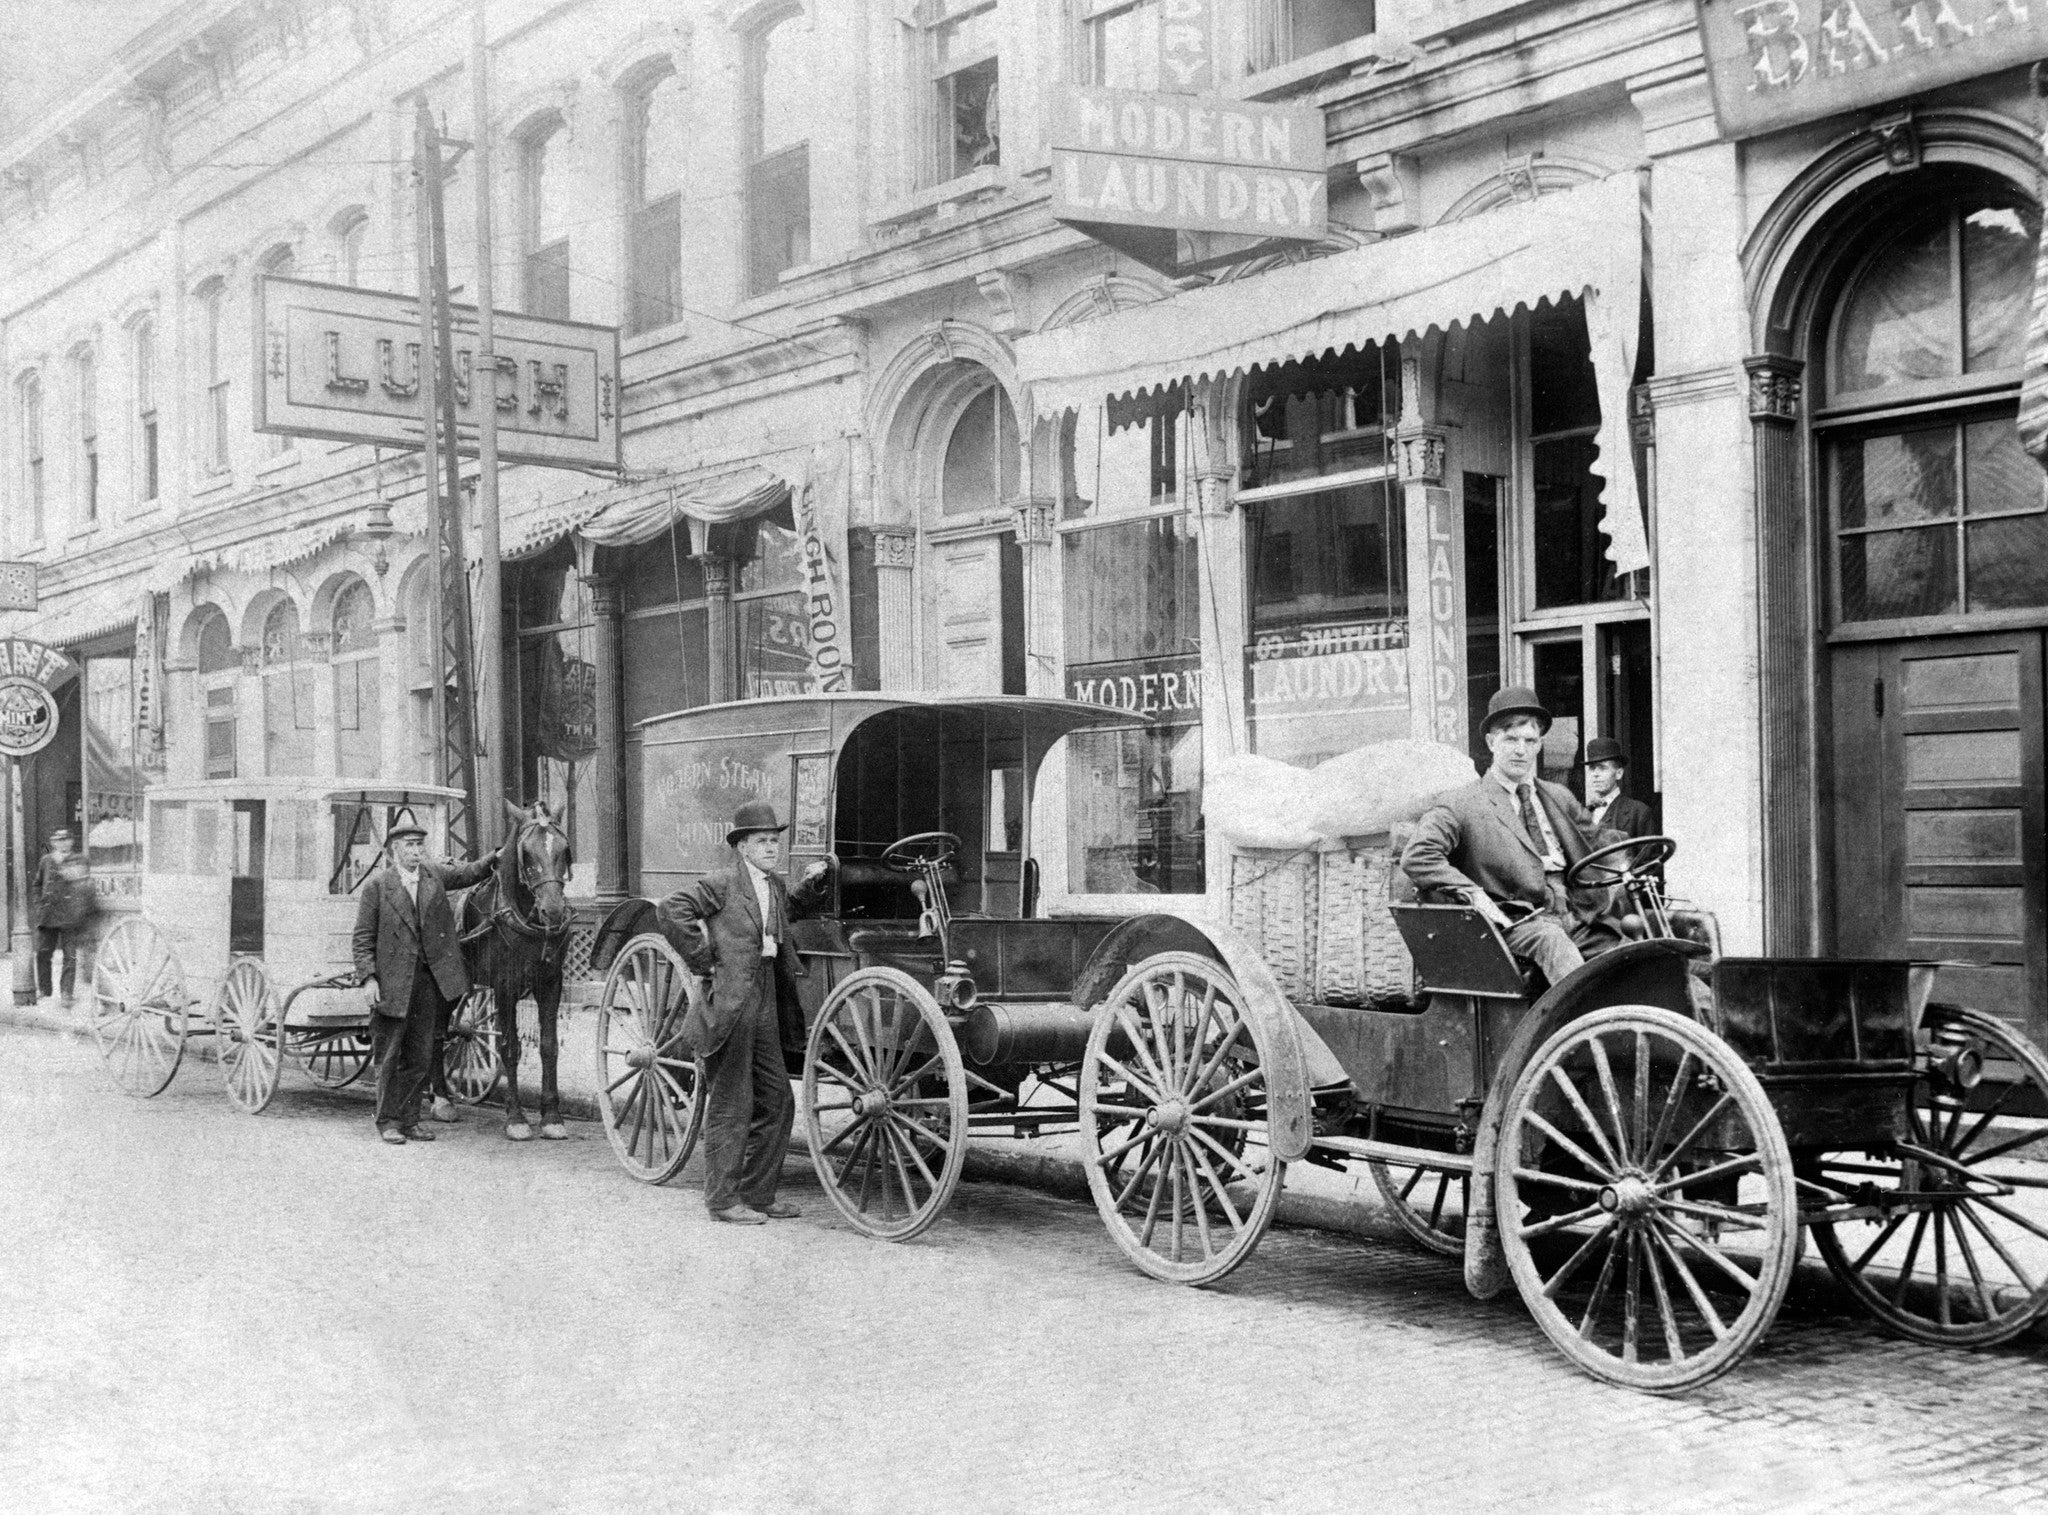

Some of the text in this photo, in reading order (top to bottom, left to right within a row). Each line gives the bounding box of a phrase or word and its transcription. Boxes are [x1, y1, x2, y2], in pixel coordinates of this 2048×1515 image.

[1080, 98, 1291, 163] MODERN
[1064, 154, 1323, 227] LAUNDRY
[1074, 669, 1203, 712] MODERN
[1249, 650, 1409, 702] LAUNDRY
[720, 755, 773, 800] STEAM
